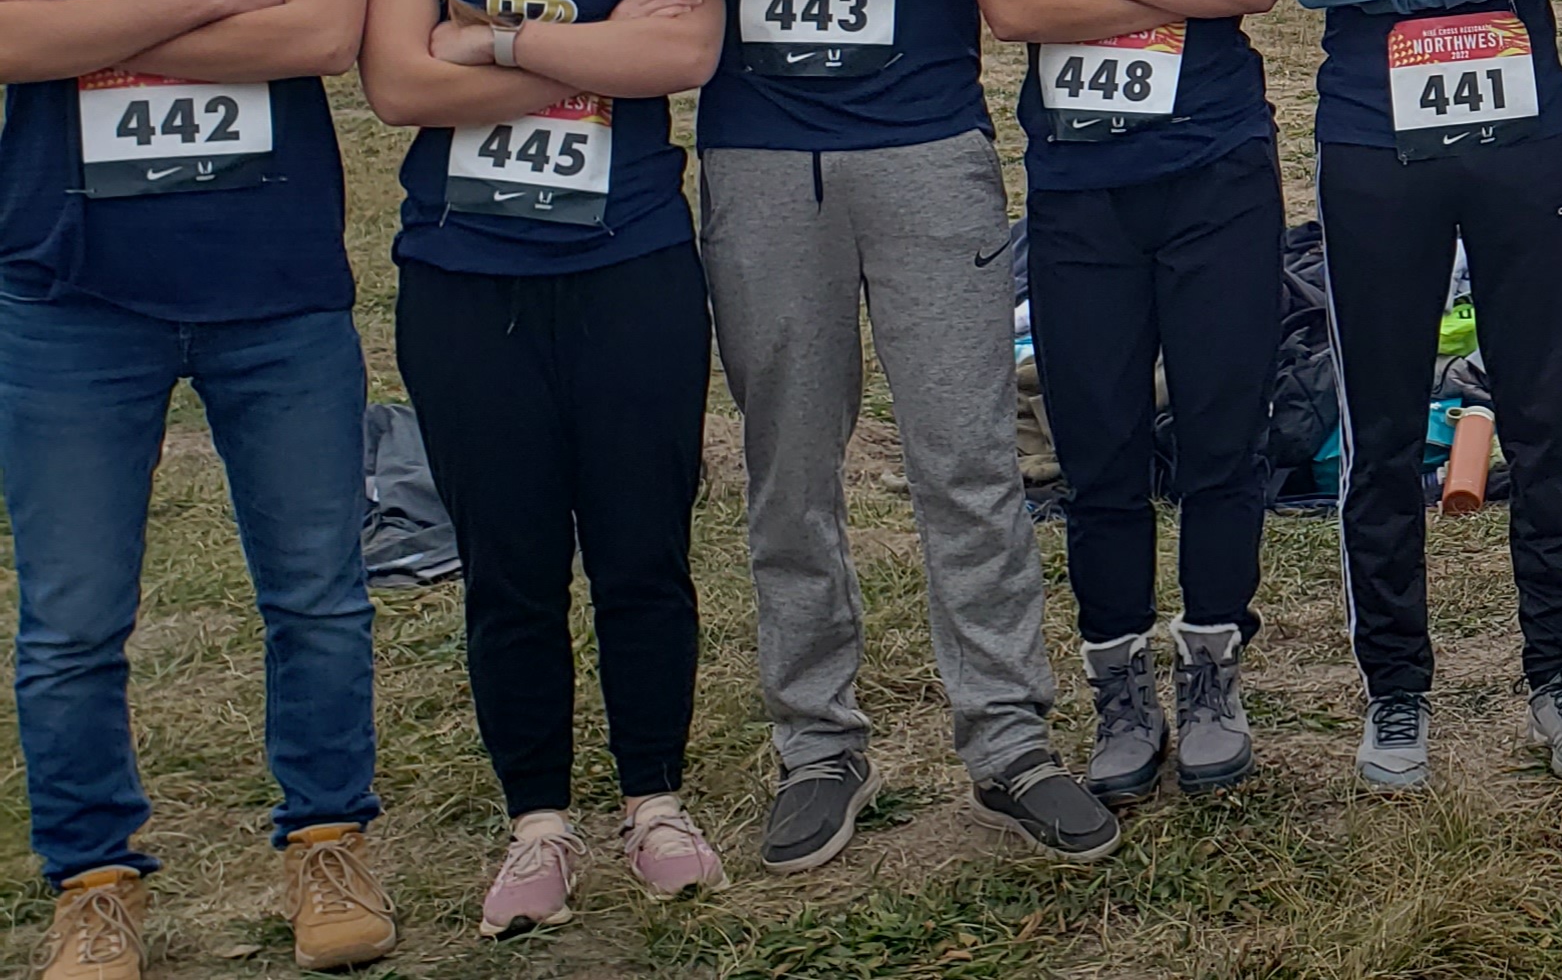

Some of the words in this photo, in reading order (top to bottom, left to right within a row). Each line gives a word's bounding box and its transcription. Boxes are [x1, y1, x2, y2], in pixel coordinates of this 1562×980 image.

[1413, 31, 1505, 55] NORTHWEST
[1450, 50, 1470, 60] 2022
[1055, 56, 1153, 102] 448
[1419, 68, 1506, 117] 441
[116, 95, 241, 146] 442
[477, 124, 588, 177] 445
